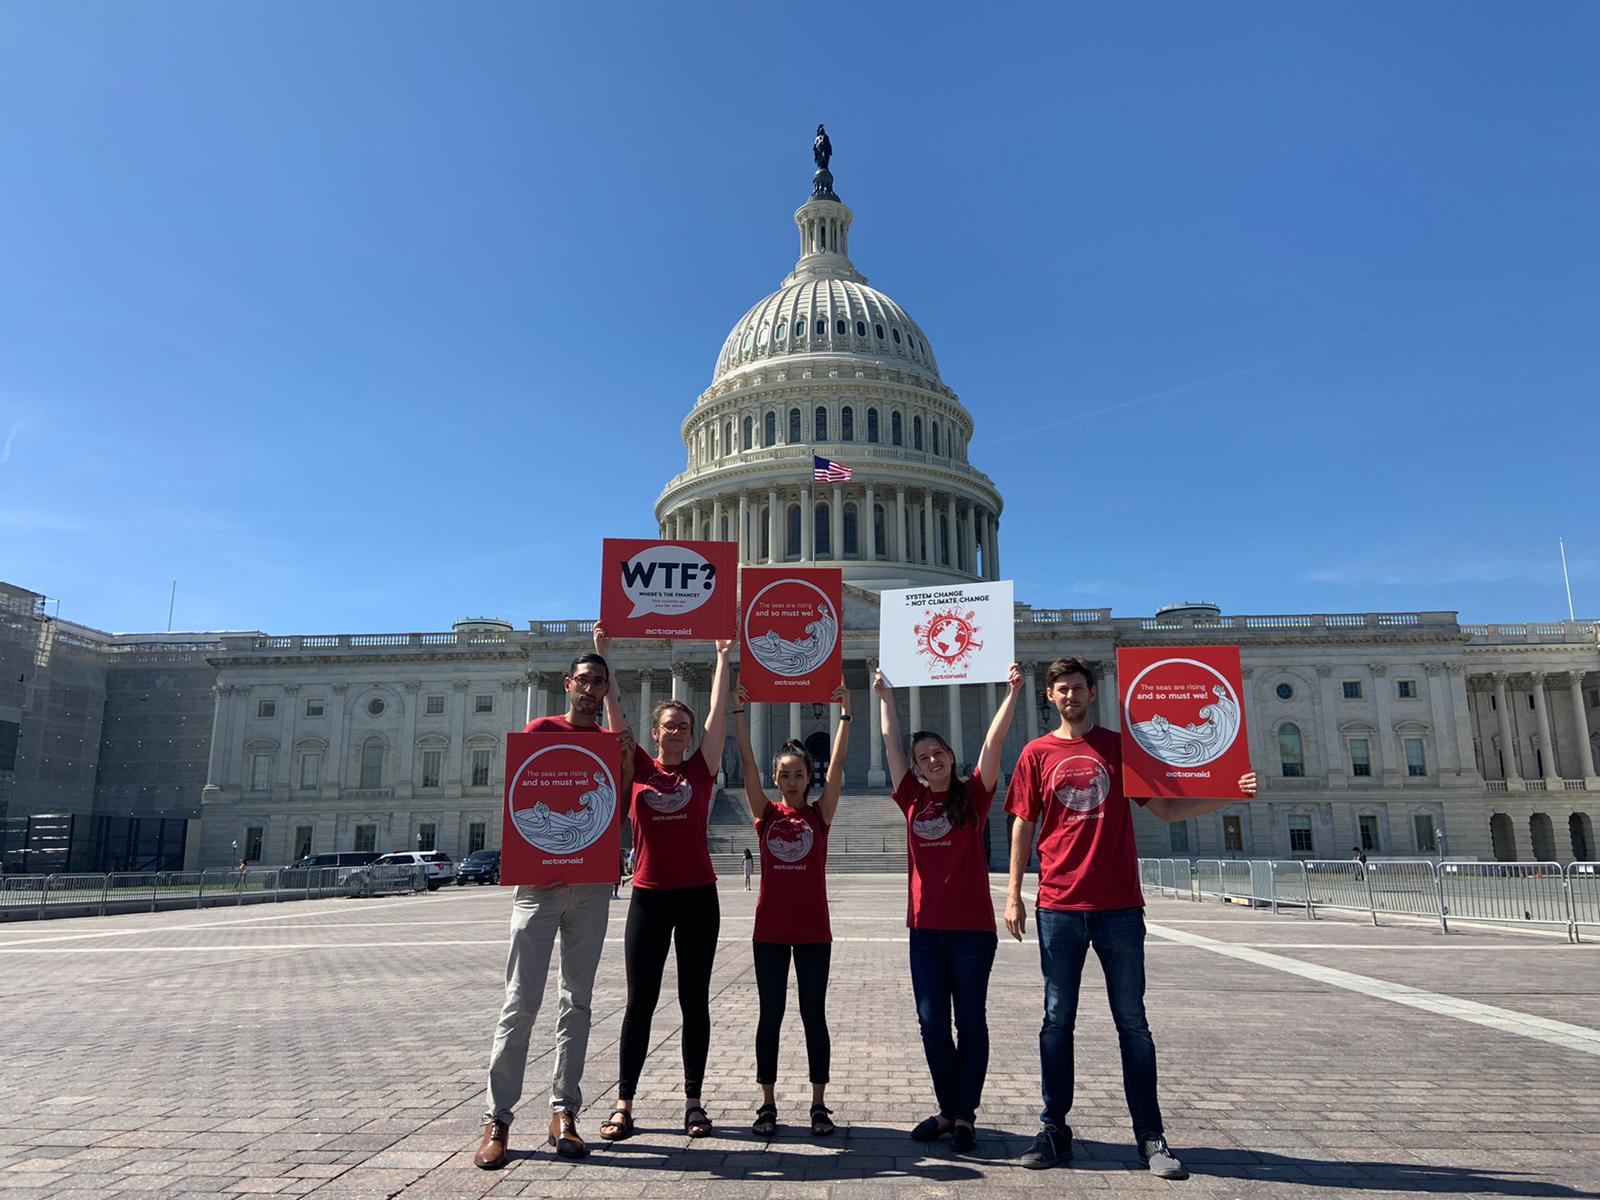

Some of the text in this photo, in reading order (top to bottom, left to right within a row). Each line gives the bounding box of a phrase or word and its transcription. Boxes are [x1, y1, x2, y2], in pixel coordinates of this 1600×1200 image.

[621, 561, 716, 590] WTF?
[905, 590, 963, 601] SYSTEM CHANGE
[928, 597, 957, 606] CLIMATE
[958, 595, 990, 603] CHANGE
[797, 602, 812, 610] rising
[1187, 684, 1206, 692] rising
[1137, 692, 1153, 700] and
[1168, 692, 1191, 700] must
[1192, 692, 1208, 700] we!
[569, 770, 588, 778] rising
